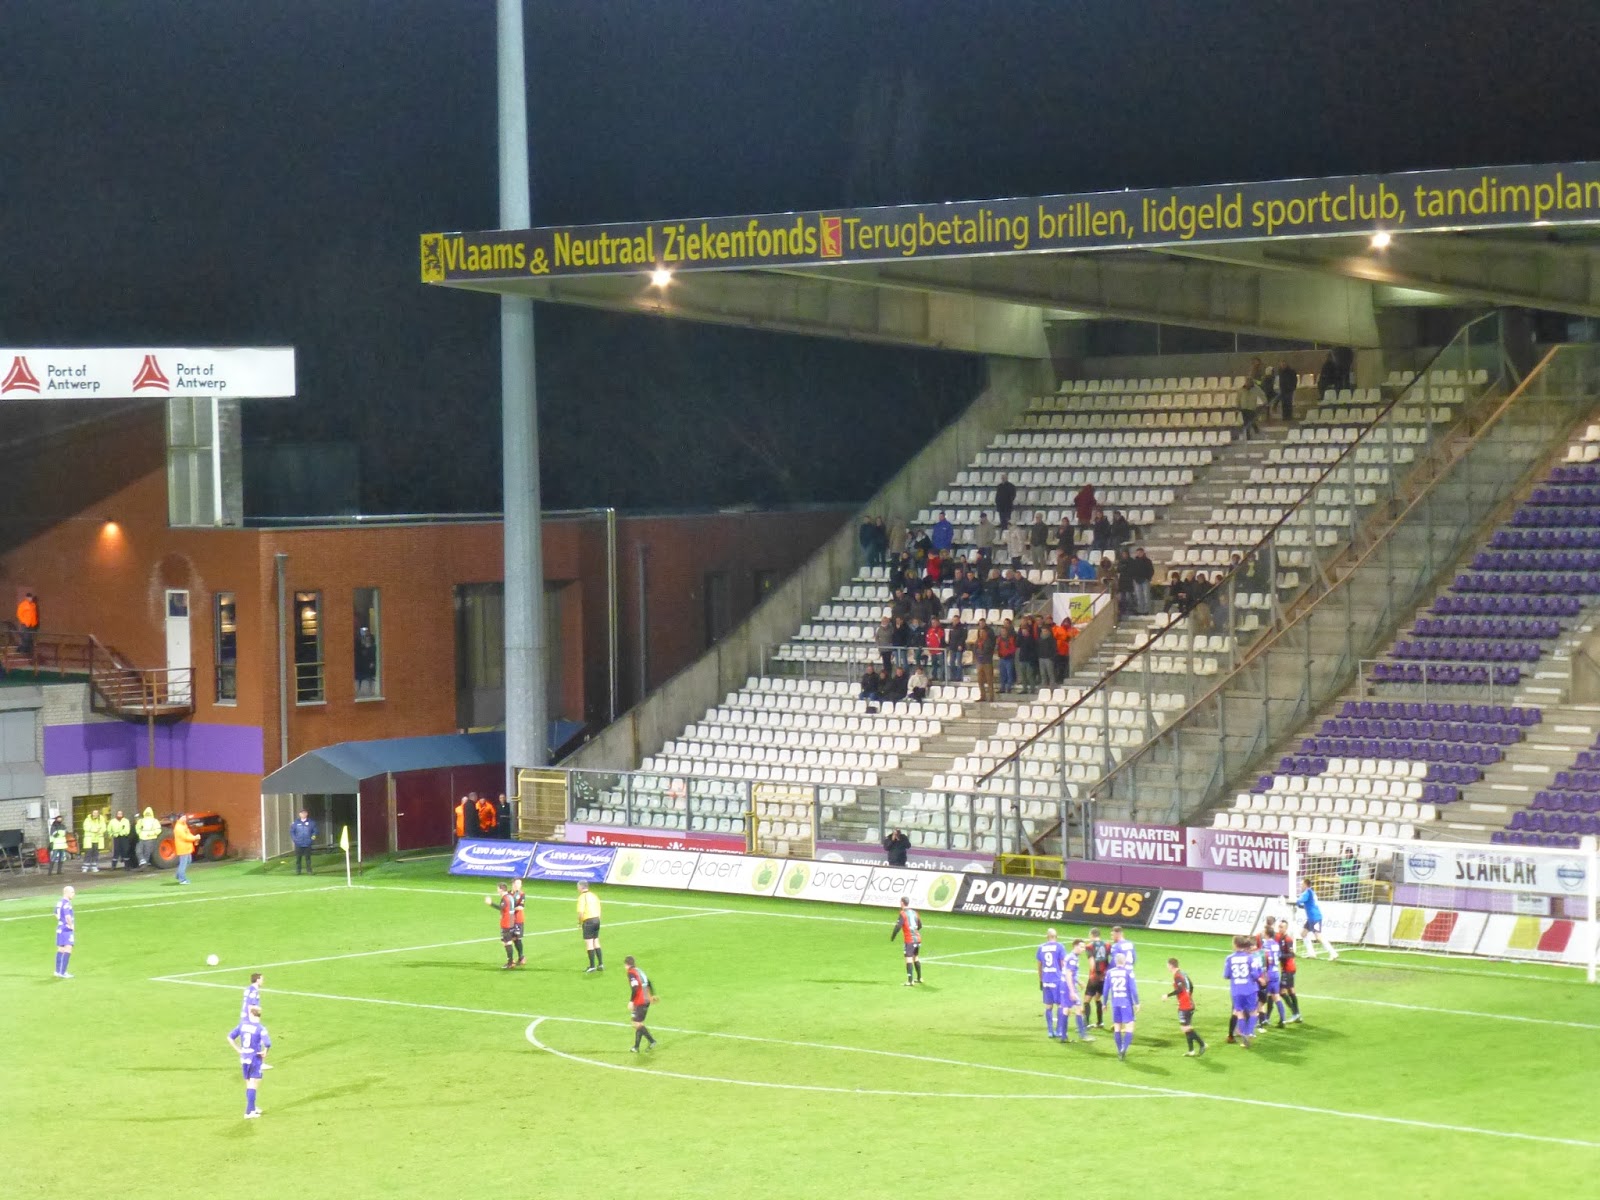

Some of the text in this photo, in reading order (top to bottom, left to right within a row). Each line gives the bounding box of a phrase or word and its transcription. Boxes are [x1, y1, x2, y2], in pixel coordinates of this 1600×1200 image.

[444, 171, 1600, 275] Vlaams & Neutraal Ziekenfonds Terugbetaling brillen, lidgeld sportclub, tandimplan
[47, 364, 88, 377] Port of
[176, 363, 215, 376] Port of
[47, 379, 101, 392] Antwerp
[176, 377, 227, 391] Antwerp
[1099, 825, 1180, 843] UITVAARTEN
[1215, 833, 1290, 850] UITVAARTE
[1095, 838, 1185, 863] VERWILT
[811, 866, 919, 894] broeckaert
[966, 879, 1143, 917] POWERPLUS
[962, 902, 1063, 920] HIGH QUALITY TOOLS
[1185, 906, 1258, 924] BEGETUBE
[1044, 952, 1054, 967] 9
[1231, 963, 1250, 978] 33
[1110, 977, 1127, 991] 22
